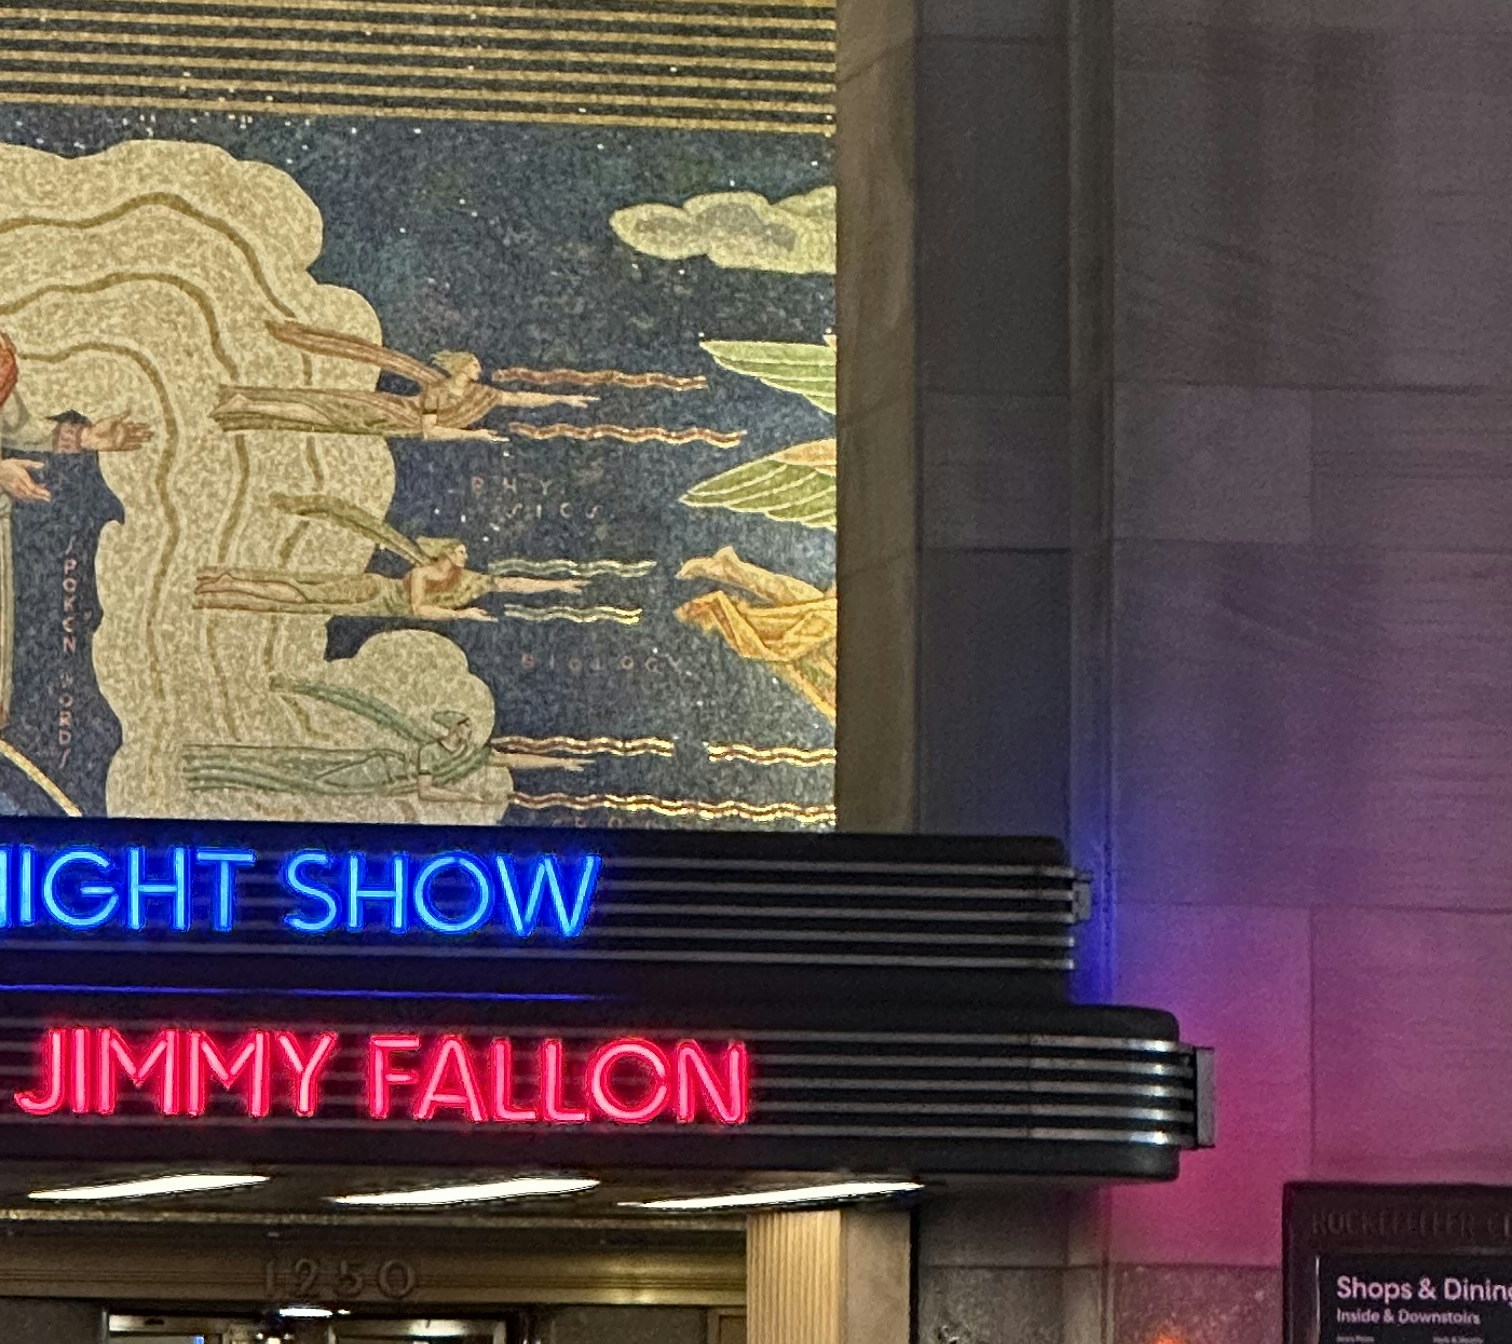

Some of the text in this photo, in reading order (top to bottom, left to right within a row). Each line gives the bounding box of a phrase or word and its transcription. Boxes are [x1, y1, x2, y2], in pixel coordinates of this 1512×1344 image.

[58, 535, 78, 769] SPOKEN WORDS
[281, 849, 601, 938] SHOW
[13, 1026, 336, 1117] JIMMY
[365, 1033, 749, 1124] FALLON
[264, 1257, 418, 1299] 1250
[1337, 1275, 1413, 1304] Shops
[1417, 1277, 1437, 1300] &
[1337, 1308, 1481, 1325] Inside & Downstairs
